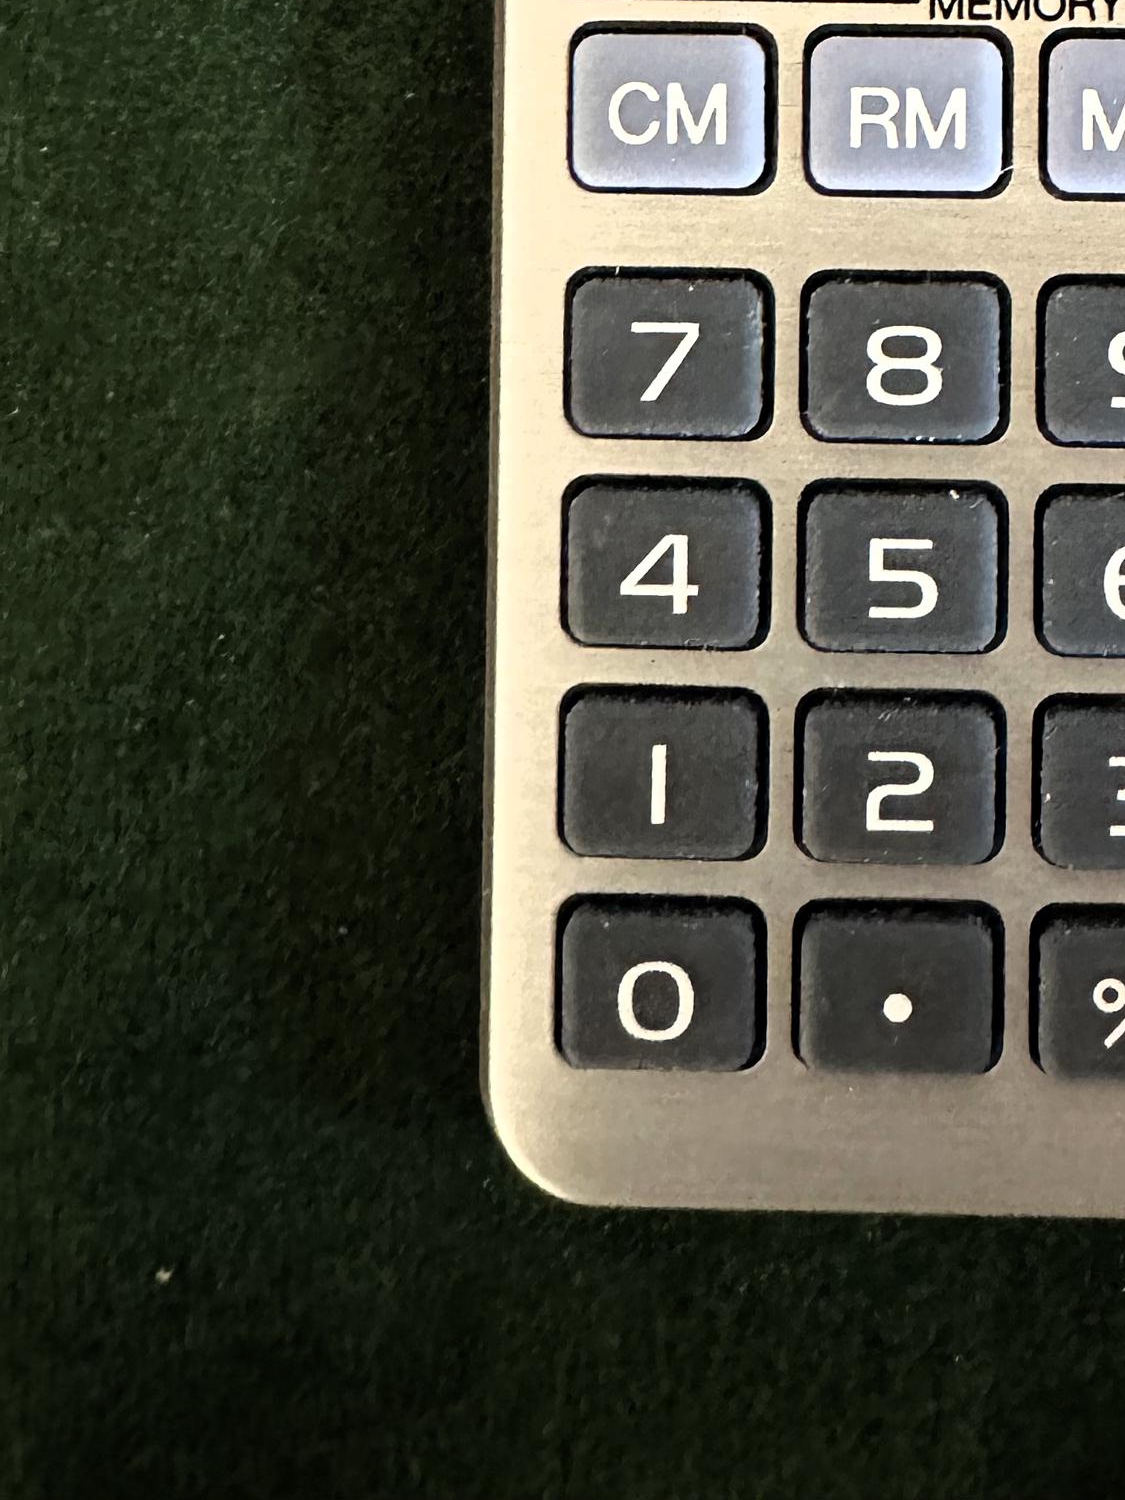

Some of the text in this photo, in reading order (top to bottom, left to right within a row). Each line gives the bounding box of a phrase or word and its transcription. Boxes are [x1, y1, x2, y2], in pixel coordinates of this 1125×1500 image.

[609, 82, 727, 145] CM
[850, 87, 966, 149] RM
[631, 322, 699, 401] 7
[867, 326, 943, 405] 8
[620, 534, 698, 614] 4
[869, 538, 938, 618] 5
[651, 745, 666, 824] 1
[866, 751, 934, 831] 2
[618, 961, 694, 1041] 0
